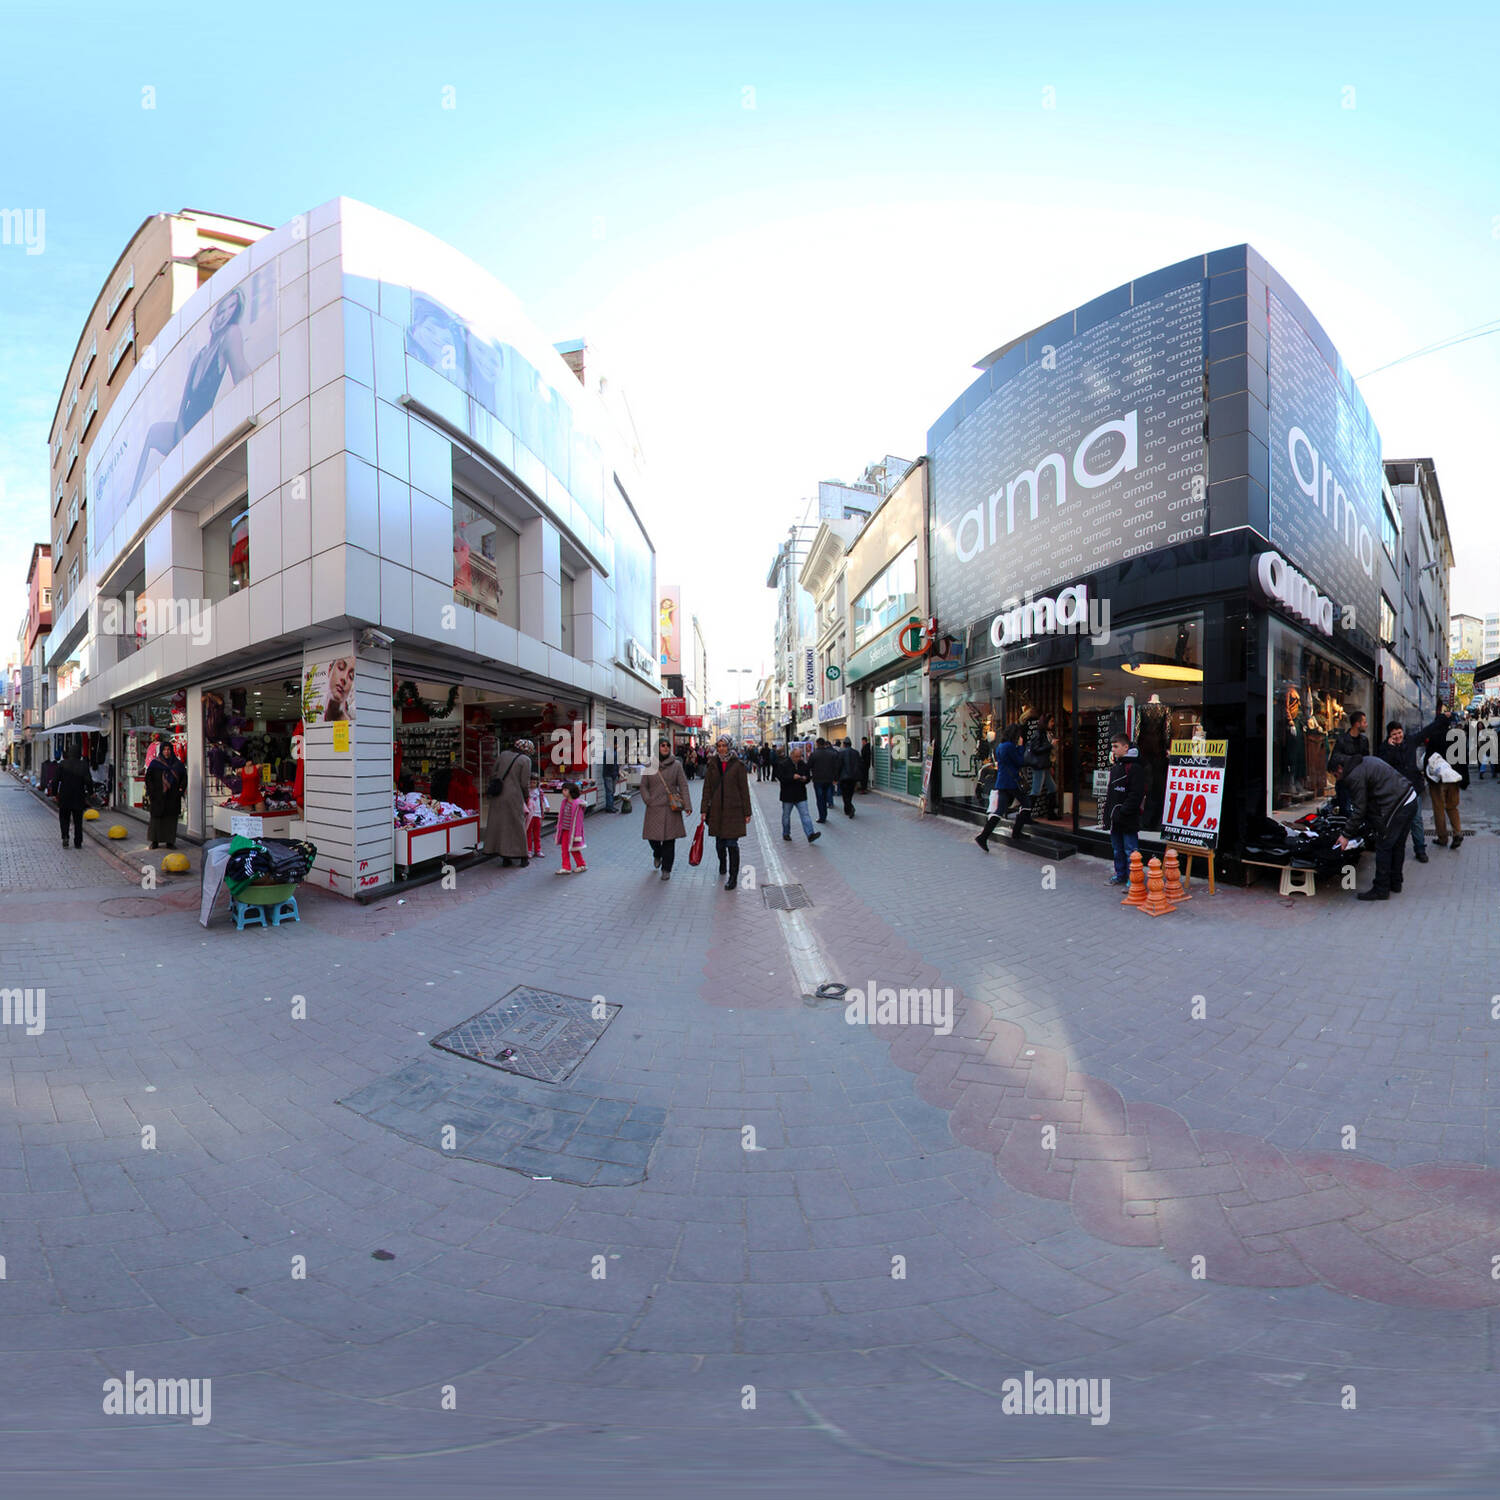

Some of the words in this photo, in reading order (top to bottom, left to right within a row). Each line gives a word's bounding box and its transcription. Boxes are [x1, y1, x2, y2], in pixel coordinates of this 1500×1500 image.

[1165, 282, 1200, 298] arma
[1166, 311, 1201, 327] arma
[1133, 350, 1165, 367] arma
[1166, 346, 1202, 362] arma
[1133, 368, 1165, 386] arma
[1167, 365, 1202, 382] arma
[1167, 386, 1202, 404] arma
[1168, 409, 1204, 428] arma
[1168, 436, 1203, 454] arma
[1134, 462, 1166, 480] arma
[1168, 463, 1203, 481] arma
[955, 408, 1139, 563] arma
[1135, 490, 1167, 508] arma
[1288, 426, 1374, 580] arma
[1123, 510, 1153, 528] arma
[1134, 520, 1166, 538] arma
[1168, 525, 1203, 544] arma
[1092, 537, 1122, 555] arma
[1123, 541, 1153, 558] arma
[1257, 551, 1334, 636] arma
[990, 584, 1089, 648] arma
[1171, 768, 1220, 780] TAKIM
[1170, 780, 1219, 793] ELBİSE
